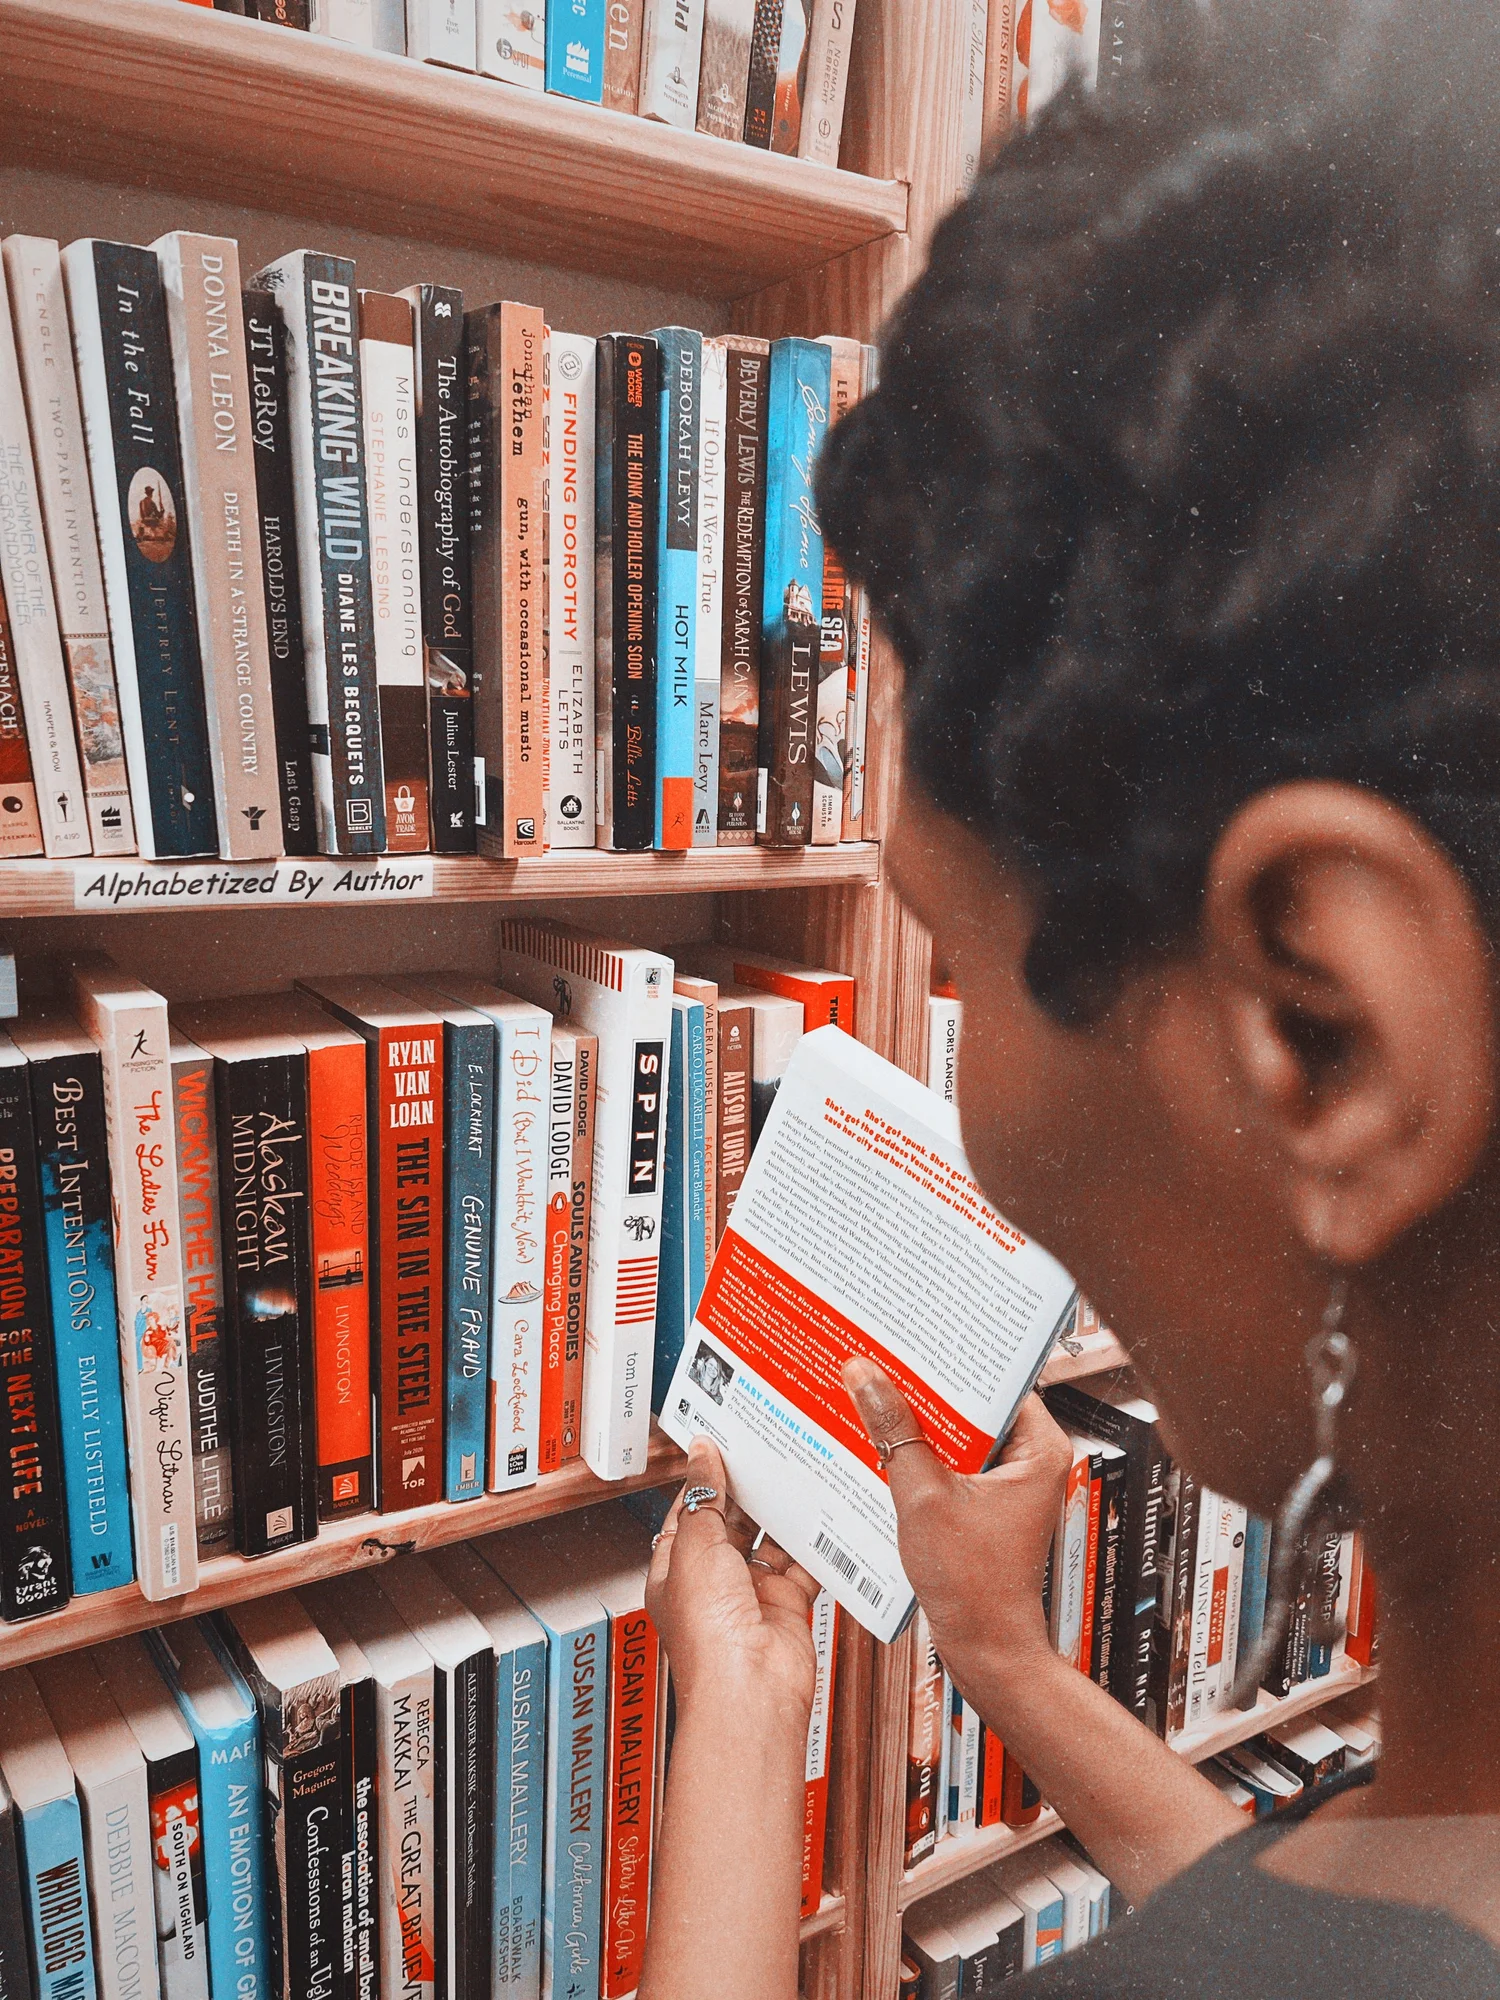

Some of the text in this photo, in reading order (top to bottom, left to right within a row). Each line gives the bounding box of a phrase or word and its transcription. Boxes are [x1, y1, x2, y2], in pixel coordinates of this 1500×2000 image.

[563, 67, 592, 83] Perennial
[822, 40, 845, 105] NORMAN LEBRECHT
[117, 284, 155, 444] In the Fall
[201, 252, 236, 453] DONNA LEON
[249, 318, 278, 452] JT LeRoy
[310, 280, 363, 561] BREAKING WILD
[677, 349, 693, 528] DEBORAH LEVY
[434, 357, 462, 638] The Autobiography of God
[563, 392, 577, 642] FINDING DOROTHY
[65, 508, 89, 617] INVENTION
[627, 434, 644, 680] THE HONK AND HOLLER OPENING SOON
[337, 574, 364, 786] DIANE LES BECQUETS
[517, 498, 531, 763] gun, with occasional music
[673, 605, 689, 707] HOT MILK
[43, 701, 56, 738] HARPER
[52, 751, 62, 772] ROW
[443, 709, 458, 790] Julius Lester
[558, 689, 569, 750] LETTS
[572, 665, 583, 774] ELIZABETH
[694, 701, 714, 793] Marc Levy
[788, 642, 811, 765] LEWIS
[395, 824, 416, 833] TRADE
[396, 813, 415, 824] AVON
[84, 868, 423, 903] Alphabetized By Author
[122, 1059, 164, 1068] KENSINGTON
[388, 1039, 436, 1067] RYAN
[394, 1070, 430, 1097] VAN
[576, 1050, 589, 1136] DAVID LODGE
[944, 1019, 955, 1102] DORIS LANGLE
[390, 1100, 434, 1128] LOAN
[550, 1061, 572, 1180] DAVID LODGE
[722, 1071, 746, 1177] ALISON LURIE
[786, 1109, 849, 1157] Bridget Jones penned
[865, 1109, 968, 1183] She's got spunk. She's got
[52, 1077, 95, 1331] BEST INTENTIONS
[231, 1113, 260, 1272] MIDNIGHT
[257, 1111, 303, 1267] Alaskan
[397, 1137, 430, 1416] THE SIN IN THE STEEL
[460, 1195, 484, 1379] GENUINE FRAUD
[546, 1230, 568, 1369] Changing Places
[565, 1180, 585, 1362] SOULS AND BODIES
[336, 1305, 352, 1404] LIVINGSTON
[623, 1352, 638, 1418] tom lowe
[7, 1373, 42, 1500] NEXT LIFE
[78, 1356, 108, 1536] EMILY LISTFIELD
[197, 1369, 218, 1452] JUDITHE
[265, 1345, 287, 1468] LIVINGSTON
[737, 1375, 763, 1401] MARY
[763, 1398, 801, 1434] PAULINE
[801, 1430, 835, 1461] LOWRY
[201, 1453, 221, 1520] LITTLE
[402, 1478, 425, 1489] TOR
[456, 1481, 479, 1491] EMBER
[1091, 1491, 1099, 1510] KIM
[16, 1576, 57, 1593] tyrant
[1083, 1574, 1094, 1604] BORN
[1083, 1610, 1092, 1636] 1982
[1192, 1559, 1212, 1684] LIVING to Tell
[417, 1698, 429, 1770] REBECCA
[570, 1632, 595, 1834] SUSAN MALLERY
[617, 1619, 646, 1826] SUSAN MALLERY
[810, 1603, 828, 1776] LITTLE NIGHT MAGIC
[916, 1672, 941, 1798] before you
[211, 1738, 256, 1765] MAFI
[293, 1759, 336, 1783] Gregory
[293, 1775, 337, 1800] Maguire
[394, 1693, 412, 1792] MAKKAI
[509, 1669, 532, 1867] SUSAN MALLERY
[963, 1728, 975, 1799] PAUL MURRAY
[105, 1804, 134, 1902] DEBBIE
[228, 1783, 256, 1967] AN EMOTION OF
[400, 1796, 422, 1911] THE GREAT
[802, 1790, 815, 1882] LUCY MARCH
[36, 1857, 86, 1974] WHIRLIGIG
[172, 1823, 194, 1960] SOUTH ON HIGHLAND
[510, 1894, 523, 1982] BOARDWALK
[563, 1841, 590, 1975] California Girls
[499, 1906, 509, 1983] BOOKSHOP
[973, 1956, 987, 1993] Joyce
